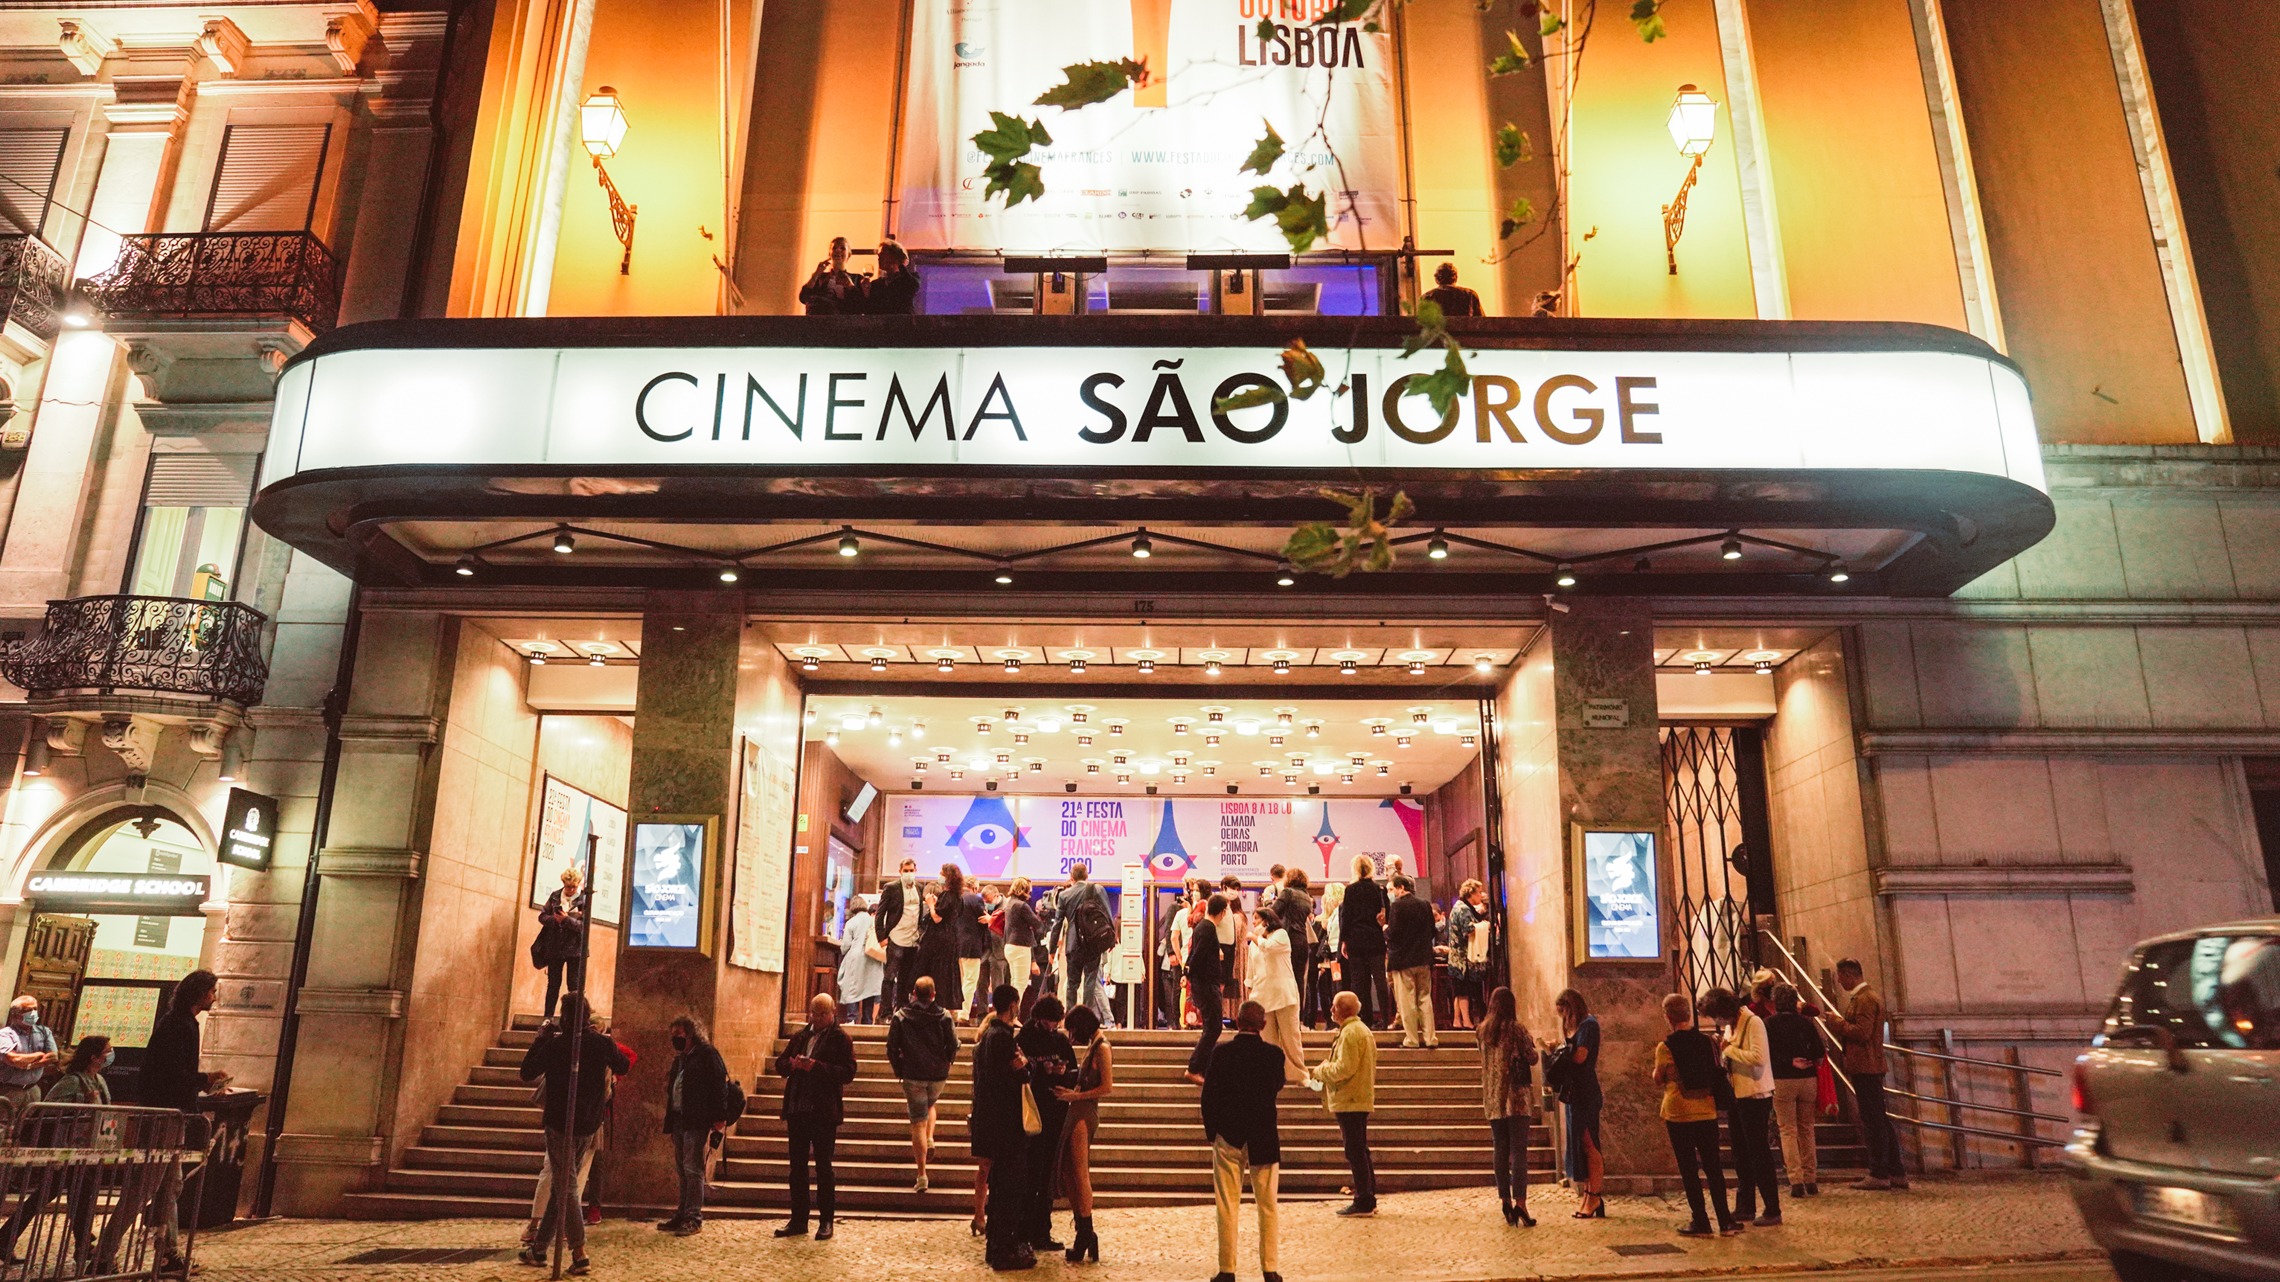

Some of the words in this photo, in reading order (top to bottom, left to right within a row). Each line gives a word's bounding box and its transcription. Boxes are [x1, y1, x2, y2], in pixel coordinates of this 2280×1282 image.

[1238, 24, 1364, 68] LISBOA
[635, 371, 1029, 443] CINEMA
[1077, 358, 1290, 445] SÃO
[1330, 372, 1664, 446] JORGE
[1134, 600, 1155, 613] 175
[1086, 801, 1123, 819] FESTA
[1220, 802, 1250, 814] LISBOA
[1251, 802, 1258, 815] 8
[1259, 802, 1266, 814] A
[1268, 802, 1279, 814] 18
[1220, 815, 1256, 827] ALMADA
[1061, 820, 1077, 837] DO
[1081, 820, 1127, 838] CINEMA
[1220, 828, 1251, 840] OEIRAS
[1060, 834, 1116, 857] FRANCÊS
[1220, 841, 1259, 853] COIMBRA
[1220, 854, 1248, 866] PORTO
[28, 877, 133, 894] CAMBRIDGE
[133, 879, 206, 896] SCHOOL
